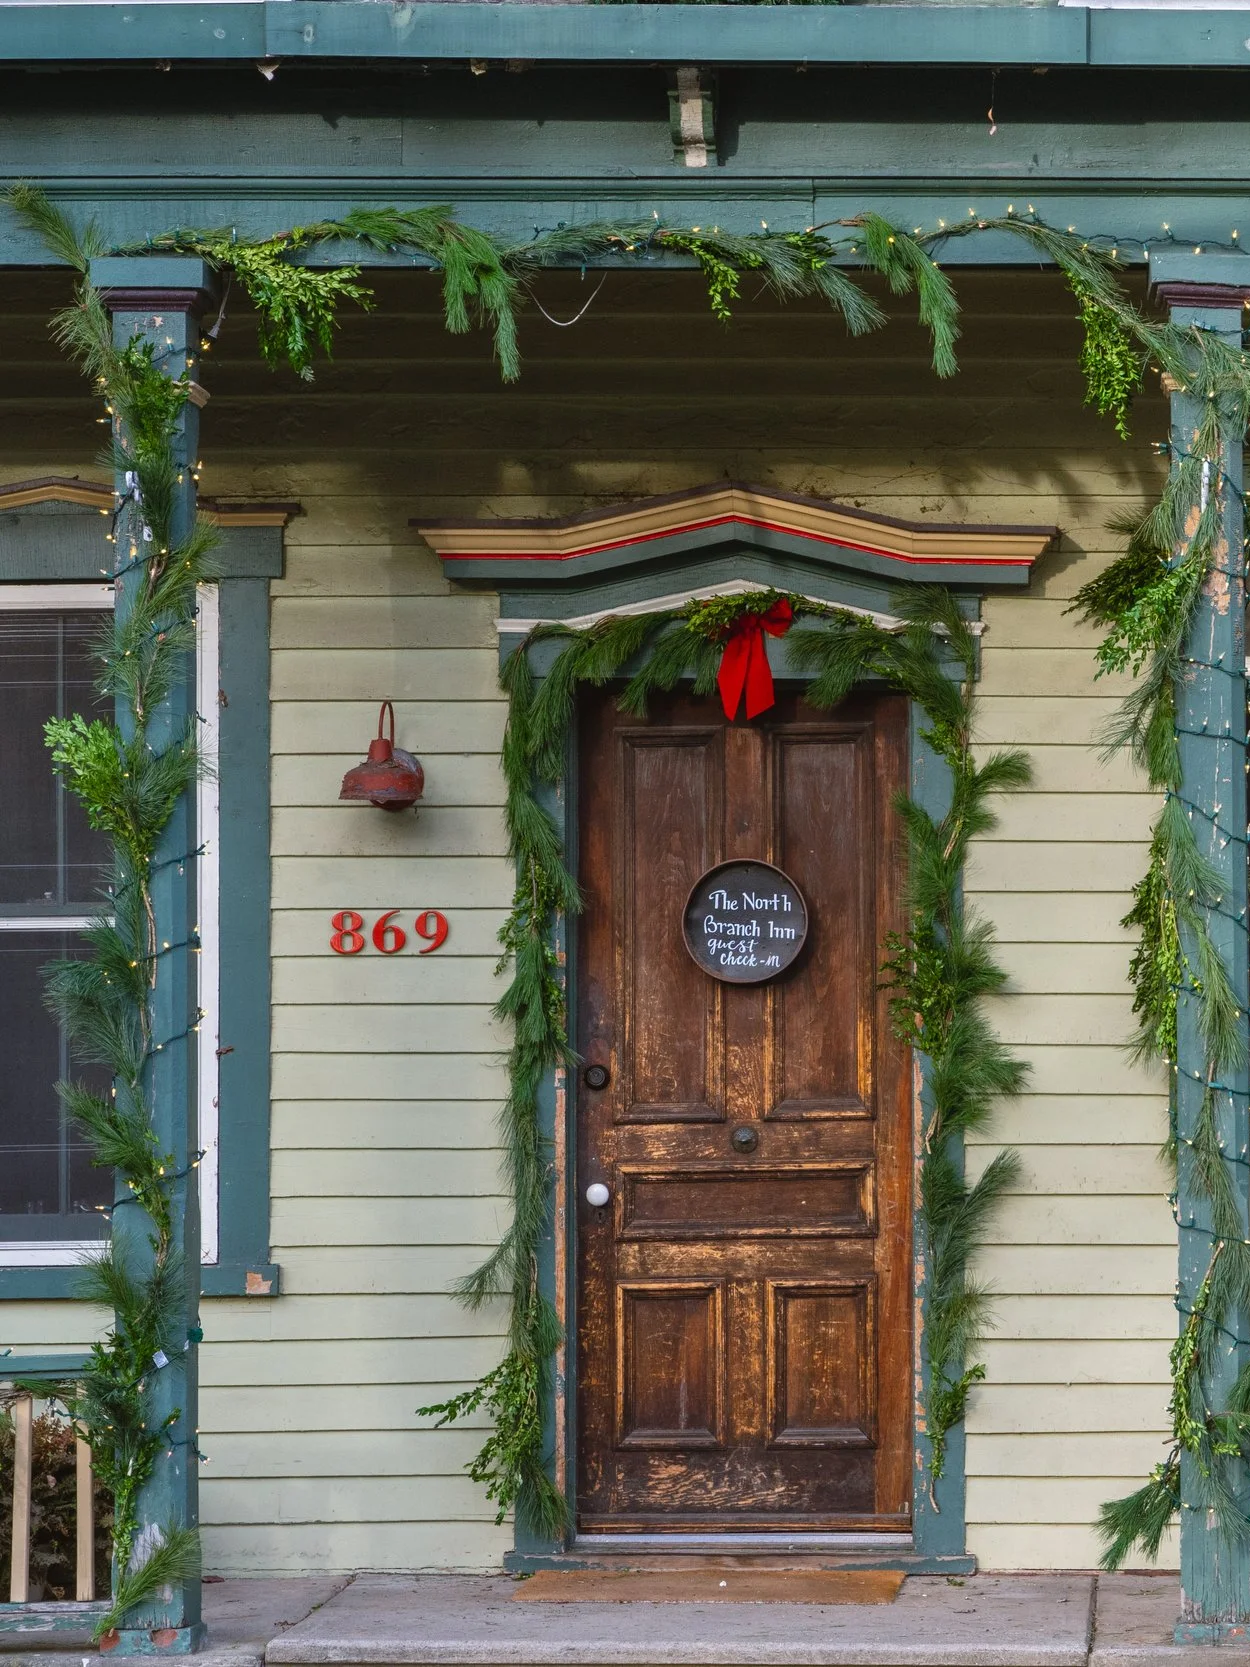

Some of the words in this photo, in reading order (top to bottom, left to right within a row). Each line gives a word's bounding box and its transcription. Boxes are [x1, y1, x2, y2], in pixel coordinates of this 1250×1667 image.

[708, 889, 739, 911] The
[742, 891, 792, 912] North
[329, 909, 449, 955] 869
[703, 914, 760, 937] Branch
[767, 920, 796, 939] Inn
[707, 938, 759, 955] guest
[720, 951, 781, 968] check-in
